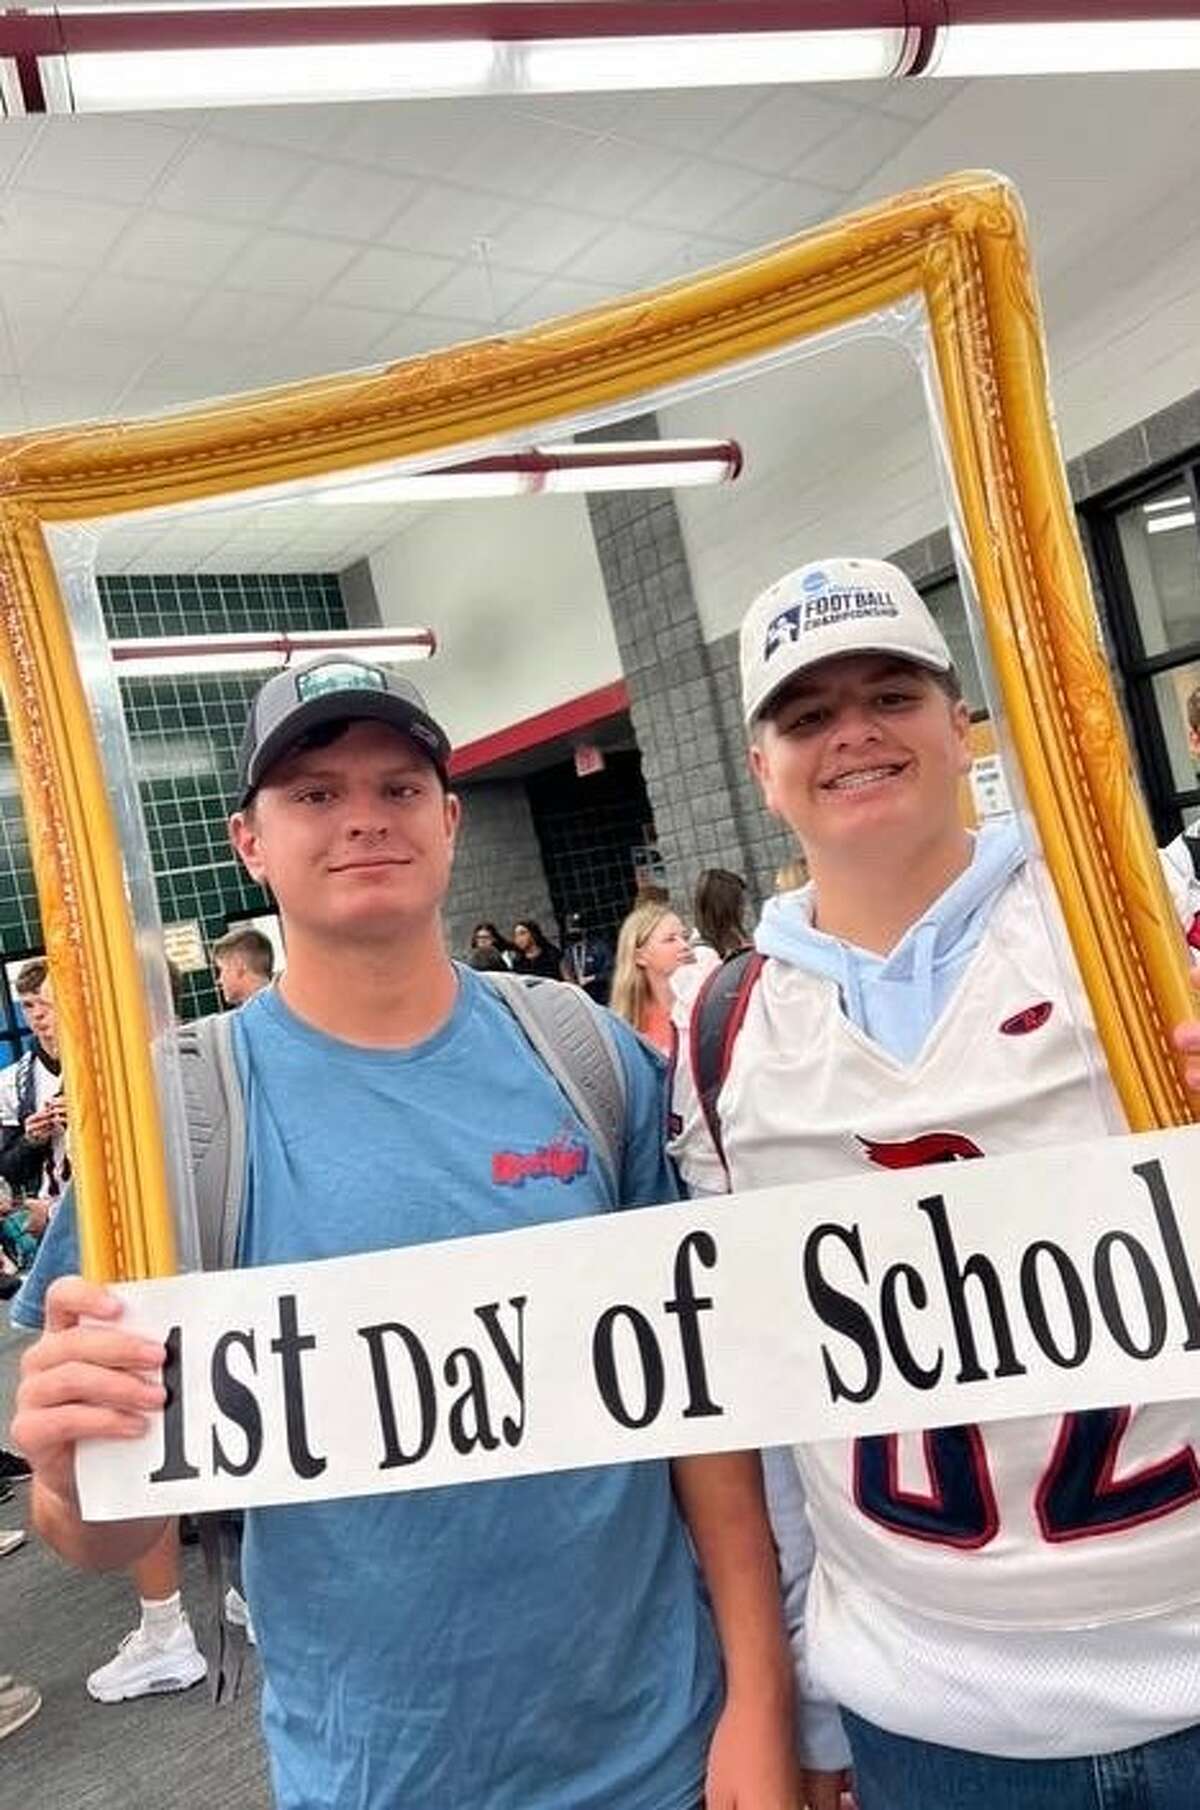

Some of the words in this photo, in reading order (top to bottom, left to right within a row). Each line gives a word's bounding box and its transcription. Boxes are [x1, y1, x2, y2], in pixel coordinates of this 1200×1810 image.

[804, 591, 896, 618] FOOTBALL
[149, 1294, 327, 1483] 1st
[357, 1295, 528, 1470] Day
[592, 1230, 724, 1429] of
[803, 1159, 1200, 1404] School
